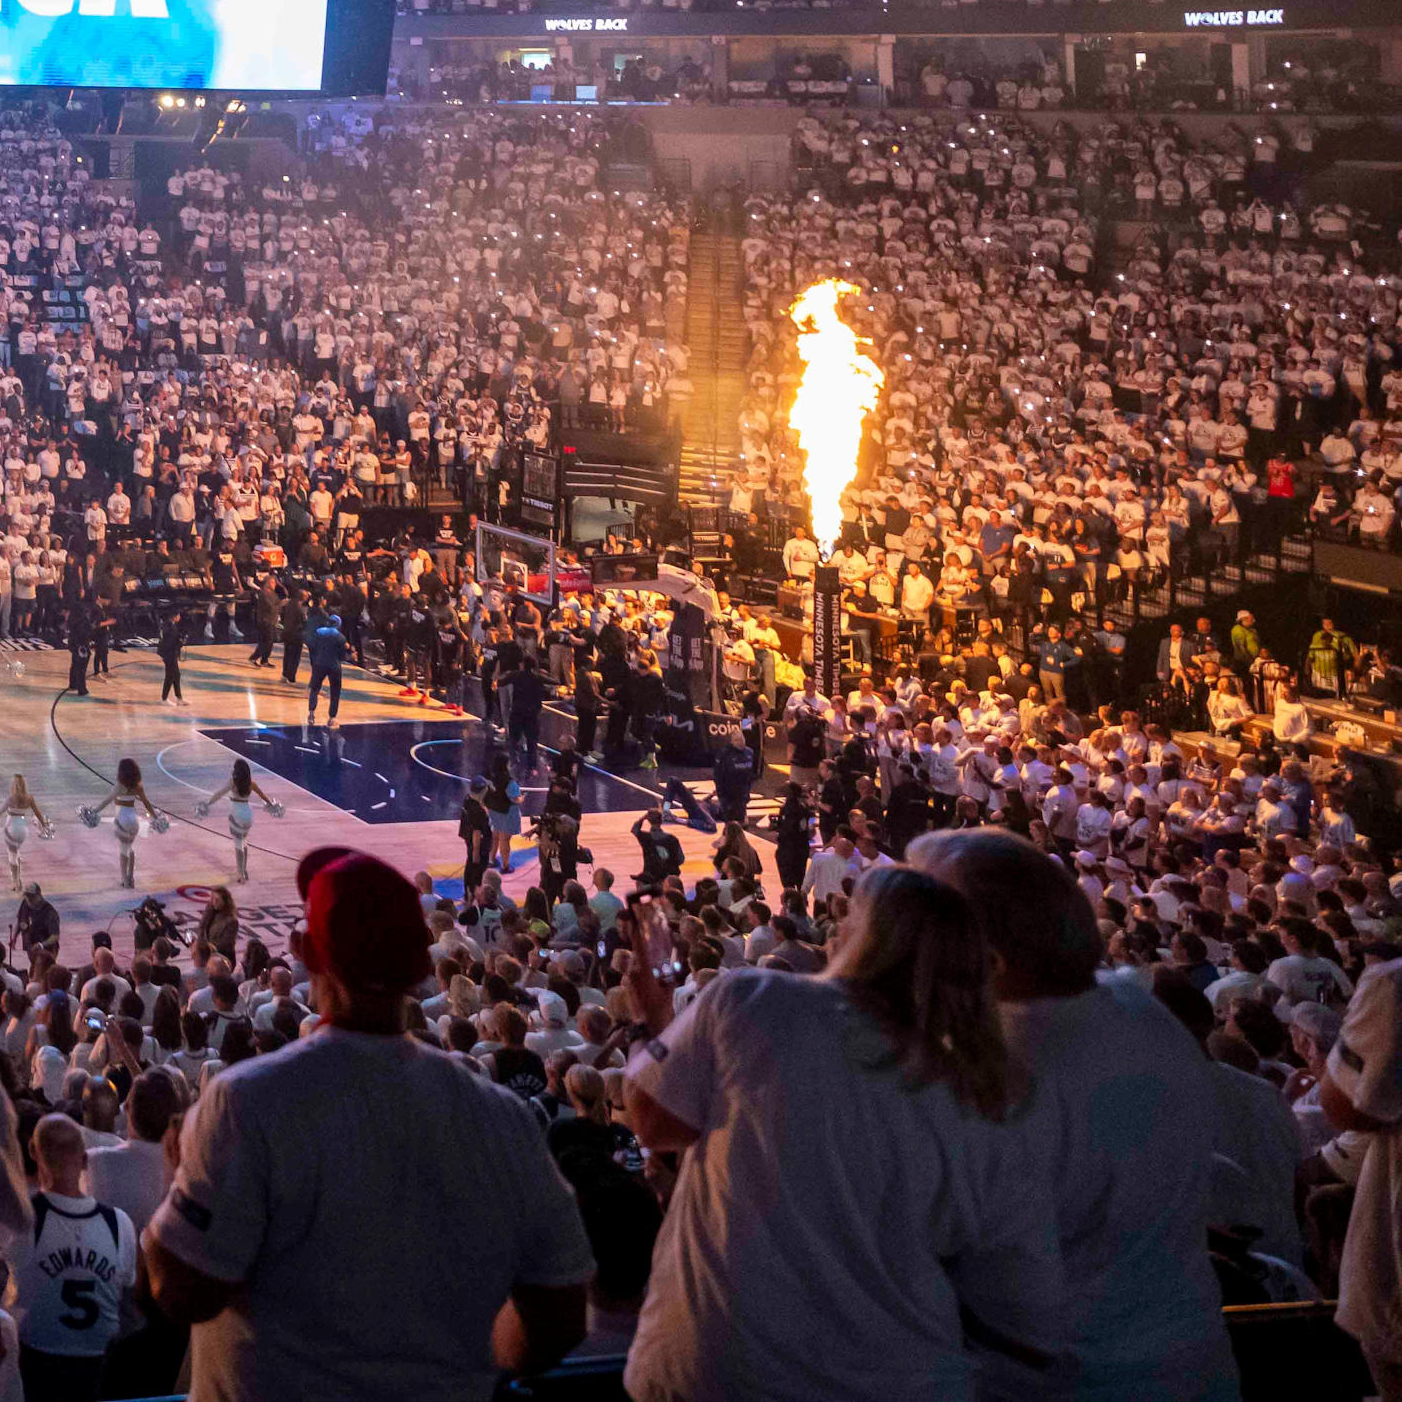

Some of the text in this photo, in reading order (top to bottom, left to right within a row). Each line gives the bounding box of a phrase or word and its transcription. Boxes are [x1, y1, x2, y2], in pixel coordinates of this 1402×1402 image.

[545, 18, 628, 31] WOLVES BACK
[1184, 8, 1284, 27] WOLVES BACK
[815, 591, 824, 656] MINNESOTA
[832, 594, 840, 659] MINNESOTA
[708, 720, 776, 738] coine
[39, 1247, 116, 1283] EDWARDS
[58, 1279, 99, 1330] 5
